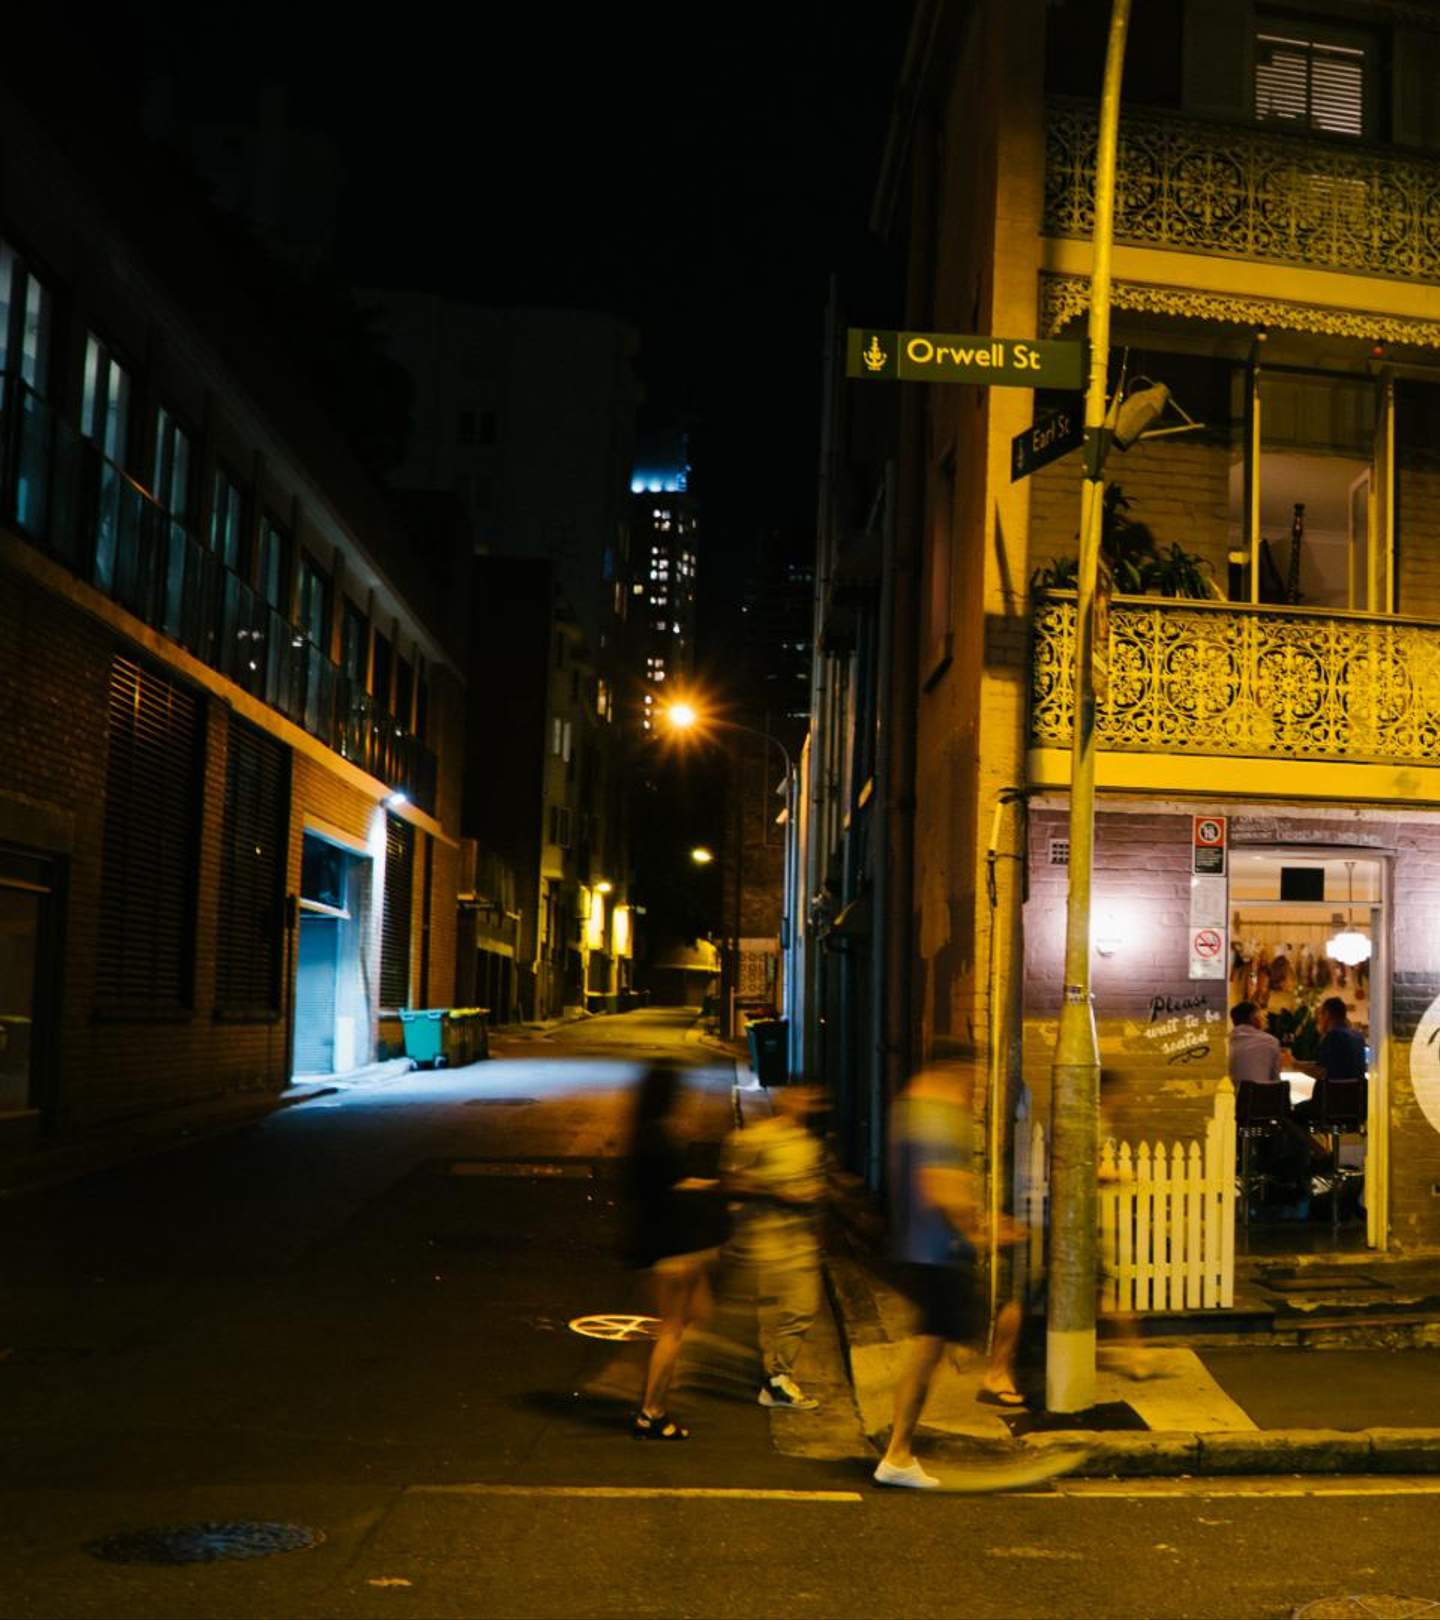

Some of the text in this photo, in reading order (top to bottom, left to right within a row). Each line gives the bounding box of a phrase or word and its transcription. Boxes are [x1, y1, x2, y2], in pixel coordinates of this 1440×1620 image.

[907, 338, 1041, 370] Orwell St
[1032, 412, 1072, 453] Earl St
[1144, 1009, 1221, 1038] wait to be
[1161, 1029, 1209, 1054] seated
